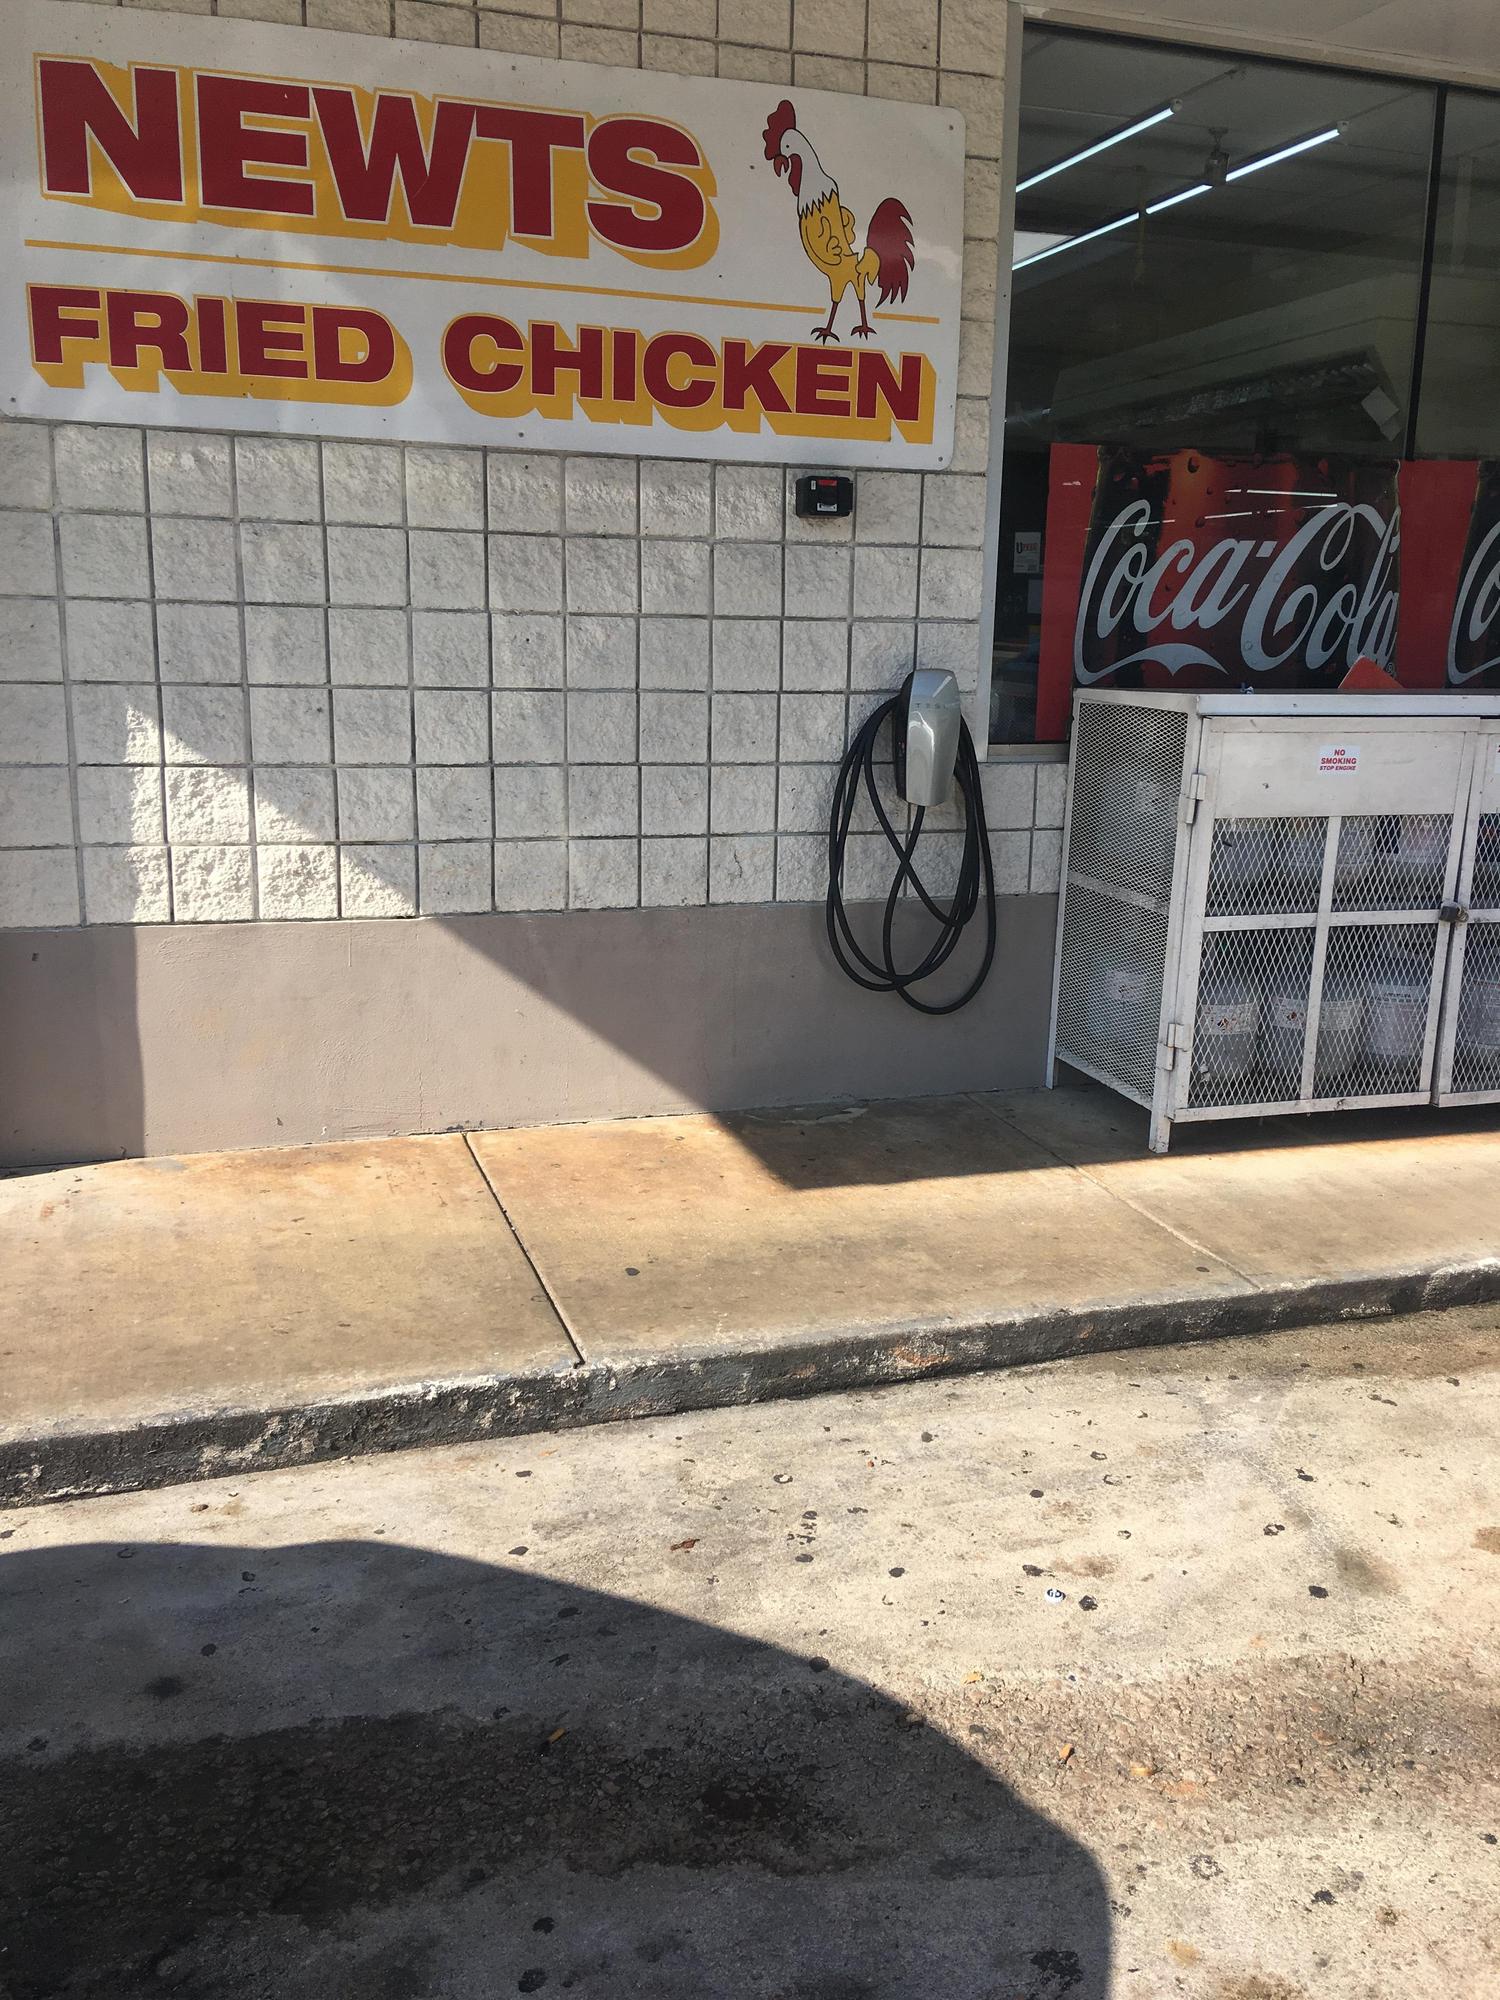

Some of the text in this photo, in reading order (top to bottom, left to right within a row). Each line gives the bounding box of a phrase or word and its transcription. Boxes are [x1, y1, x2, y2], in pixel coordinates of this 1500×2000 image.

[37, 57, 711, 258] NEWTS
[28, 285, 926, 424] FRIED CHICKEN
[1074, 499, 1401, 685] Coca-Cola
[1321, 757, 1357, 765] SMOKING
